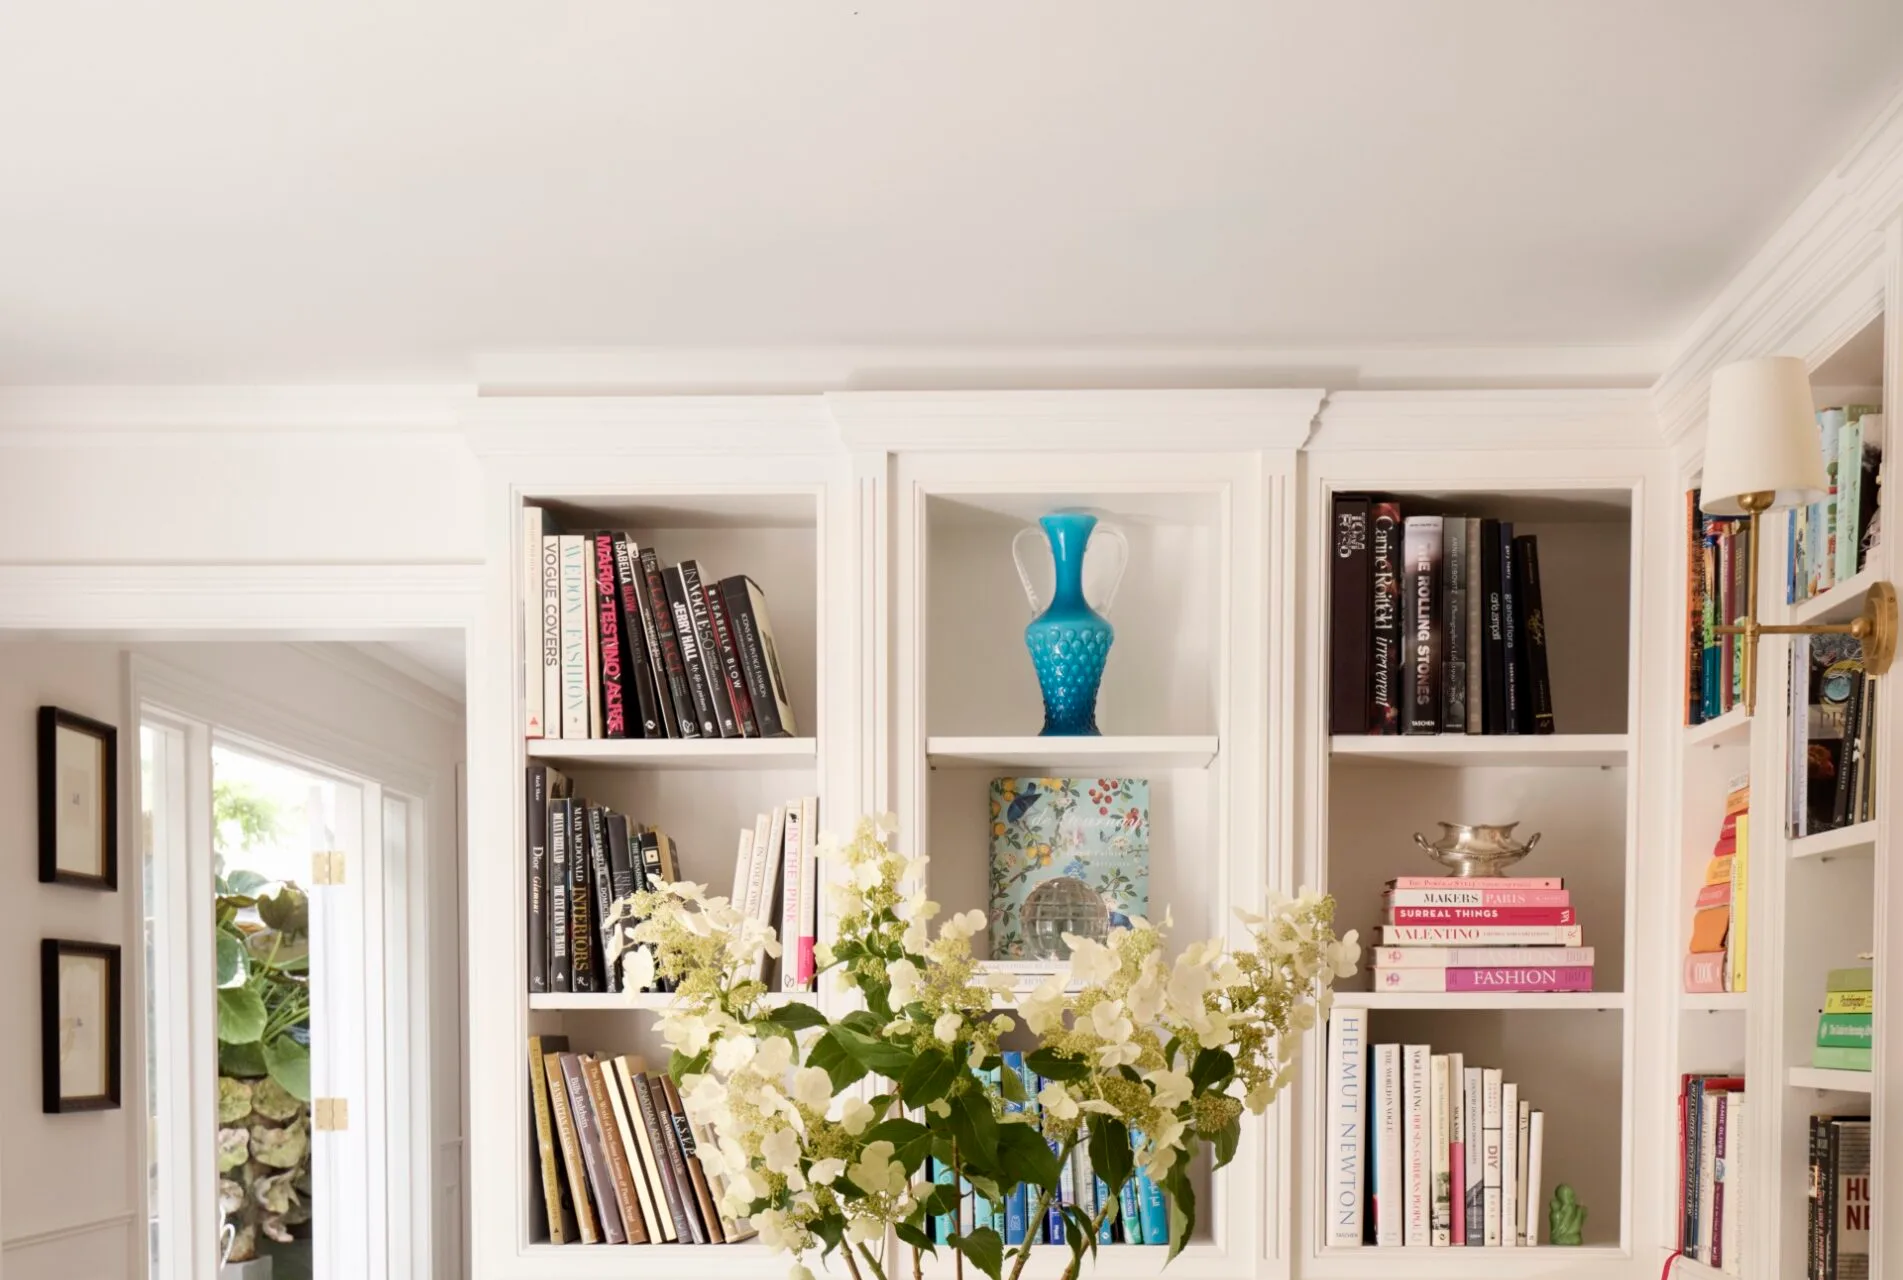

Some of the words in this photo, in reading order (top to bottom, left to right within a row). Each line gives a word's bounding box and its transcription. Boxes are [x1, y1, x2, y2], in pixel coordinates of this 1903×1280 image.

[1374, 515, 1393, 569] Carine
[545, 543, 557, 598] VOGUE
[596, 536, 613, 595] MARIO
[615, 541, 632, 584] ISABELLA
[622, 585, 636, 612] BLOW
[673, 602, 691, 634] JERRY
[1375, 572, 1393, 628] Roitfeld
[1417, 576, 1430, 640] ROLLING
[545, 604, 558, 667] COVERS
[600, 599, 618, 676] TESTINO
[1504, 593, 1514, 648] grandiflora
[681, 636, 697, 661] HALL
[711, 600, 731, 653] ISABELLA
[726, 657, 742, 689] BLOW
[1375, 636, 1393, 707] irreverent
[1417, 645, 1430, 705] STONES
[606, 681, 623, 732] ALIVE
[574, 807, 582, 831] MARY
[787, 827, 798, 842] IN
[531, 846, 543, 869] Dior
[786, 850, 798, 878] THE
[533, 876, 541, 914] Glamour
[786, 888, 797, 923] PINK
[1400, 909, 1451, 918] SURREAL
[1455, 909, 1498, 918] THINGS
[1423, 890, 1479, 904] MAKERS
[1485, 890, 1526, 904] PARIS
[573, 886, 588, 971] INTERIORS
[1394, 928, 1480, 940] VALENTINO
[1474, 970, 1556, 985] FASHION
[591, 1067, 599, 1078] The
[1342, 1017, 1359, 1112] HELMUT
[552, 1081, 567, 1126] MANHATTAN
[571, 1076, 581, 1094] Billy
[594, 1080, 603, 1100] Private
[575, 1096, 589, 1128] Baldwin
[599, 1102, 609, 1120] World
[636, 1081, 653, 1125] JONATHAN
[651, 1128, 665, 1155] ADLER
[674, 1115, 696, 1158] R.S.V.P.
[1339, 1122, 1357, 1225] NEWTON
[1488, 1145, 1498, 1169] DIY
